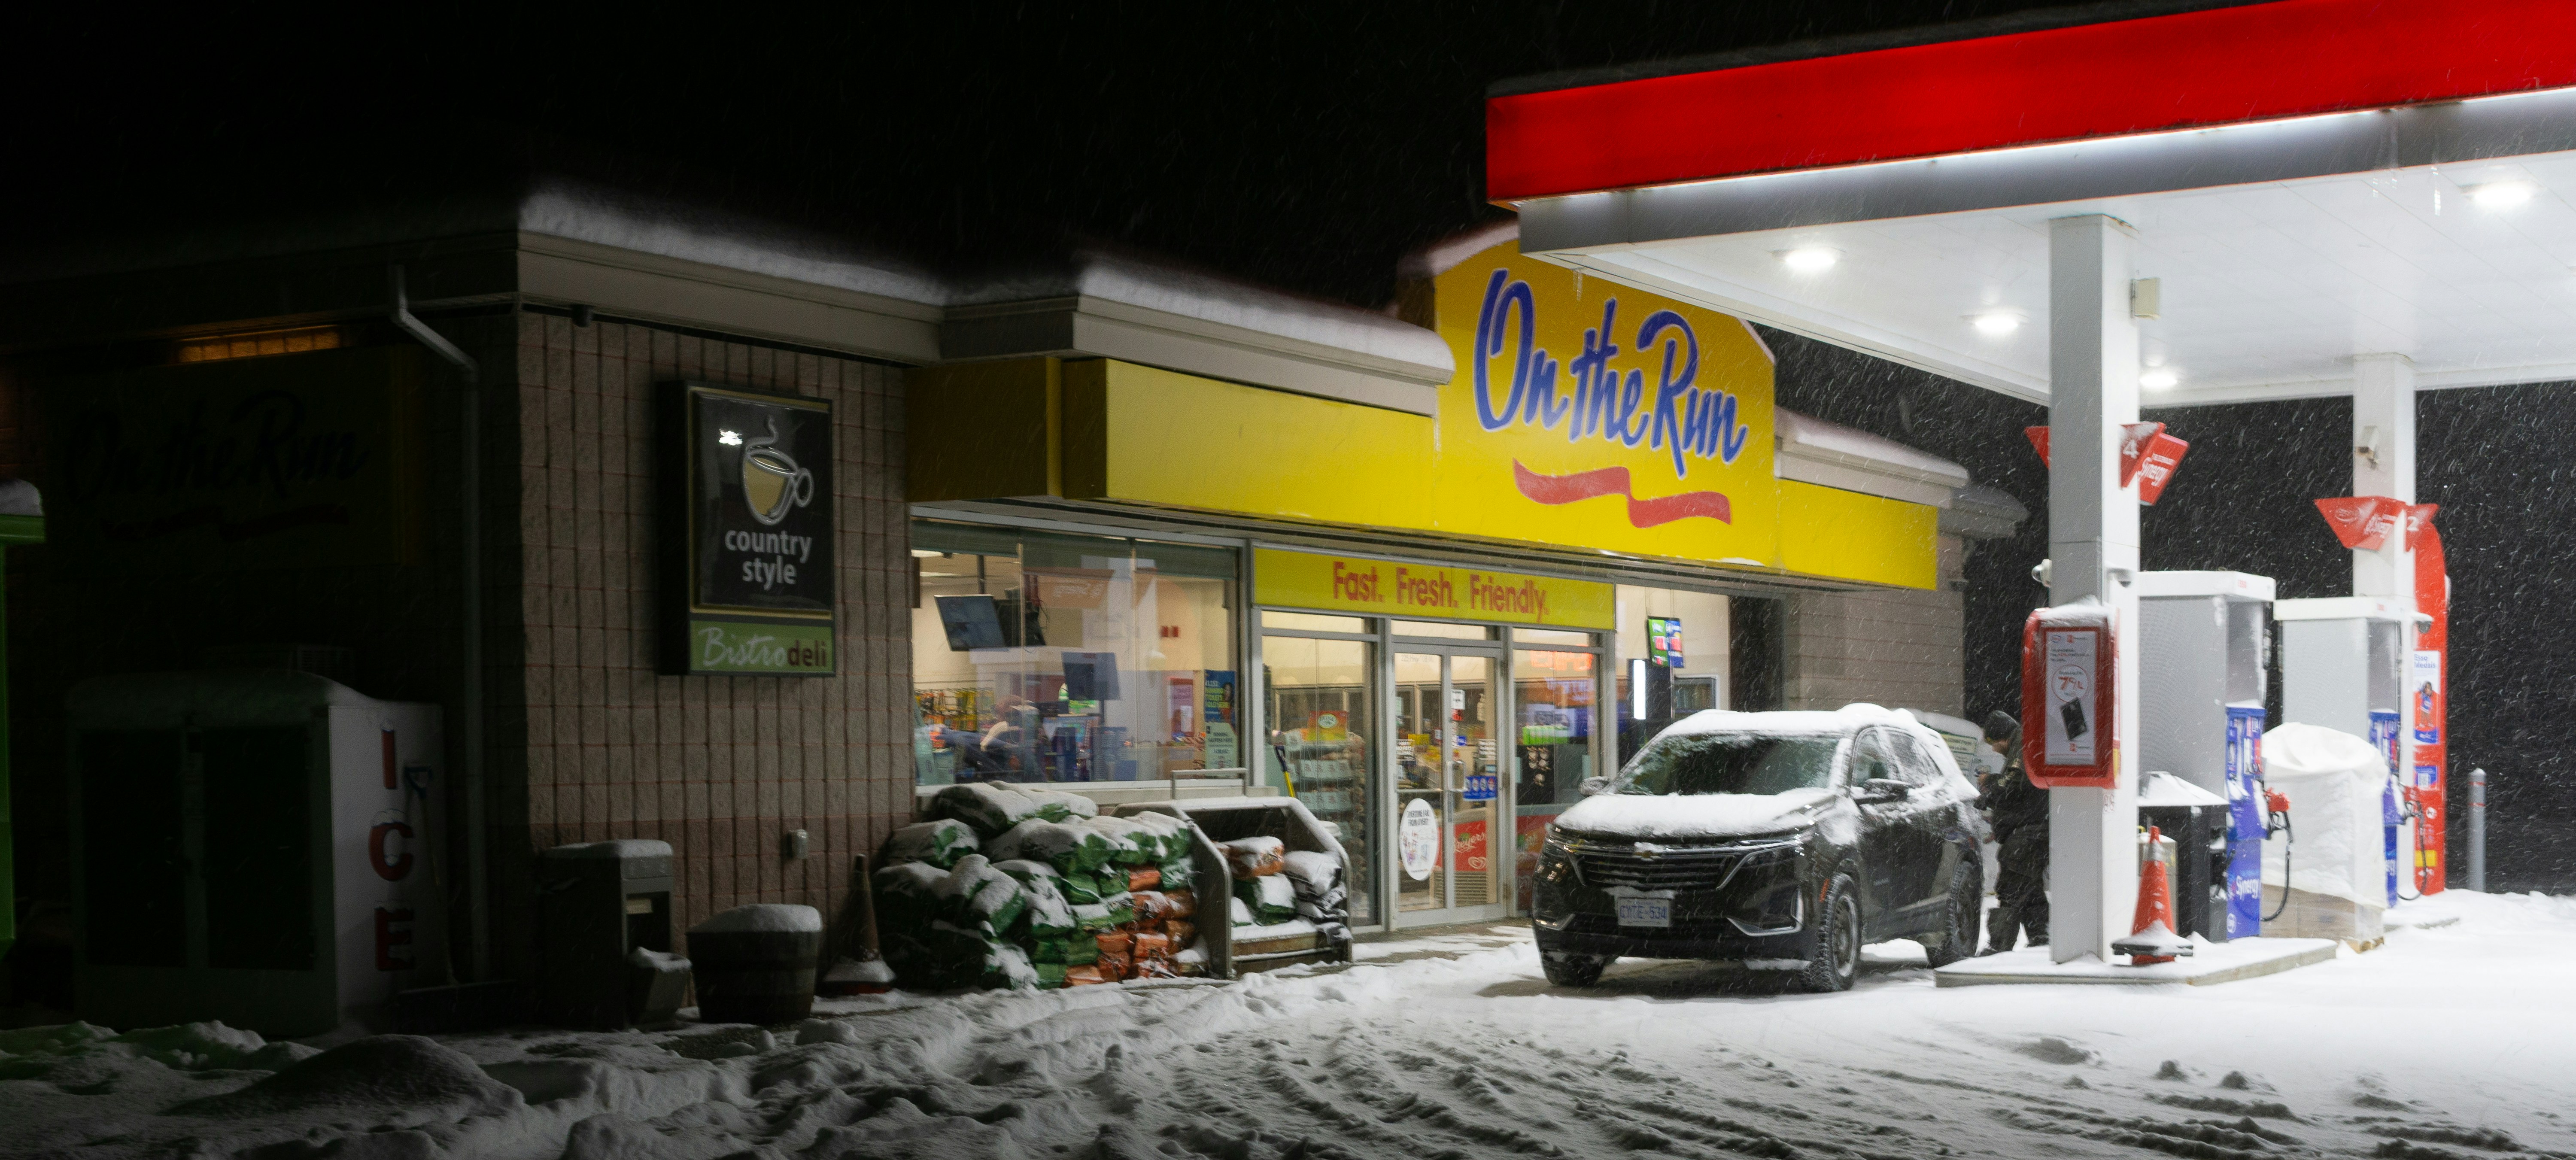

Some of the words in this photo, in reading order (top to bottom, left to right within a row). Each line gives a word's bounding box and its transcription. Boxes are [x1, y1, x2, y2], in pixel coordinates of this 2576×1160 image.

[1473, 268, 1570, 432] On
[1569, 298, 1649, 448] the
[1635, 310, 1748, 479] Run
[2122, 439, 2140, 459] 4
[2407, 516, 2419, 531] 2
[725, 529, 812, 564] country
[742, 555, 797, 590] style
[1333, 561, 1384, 602] Fast.
[1396, 567, 1458, 608] Fresh.
[1470, 574, 1550, 623] Friendly.
[370, 721, 415, 970] ICE
[2236, 875, 2260, 900] Synergy
